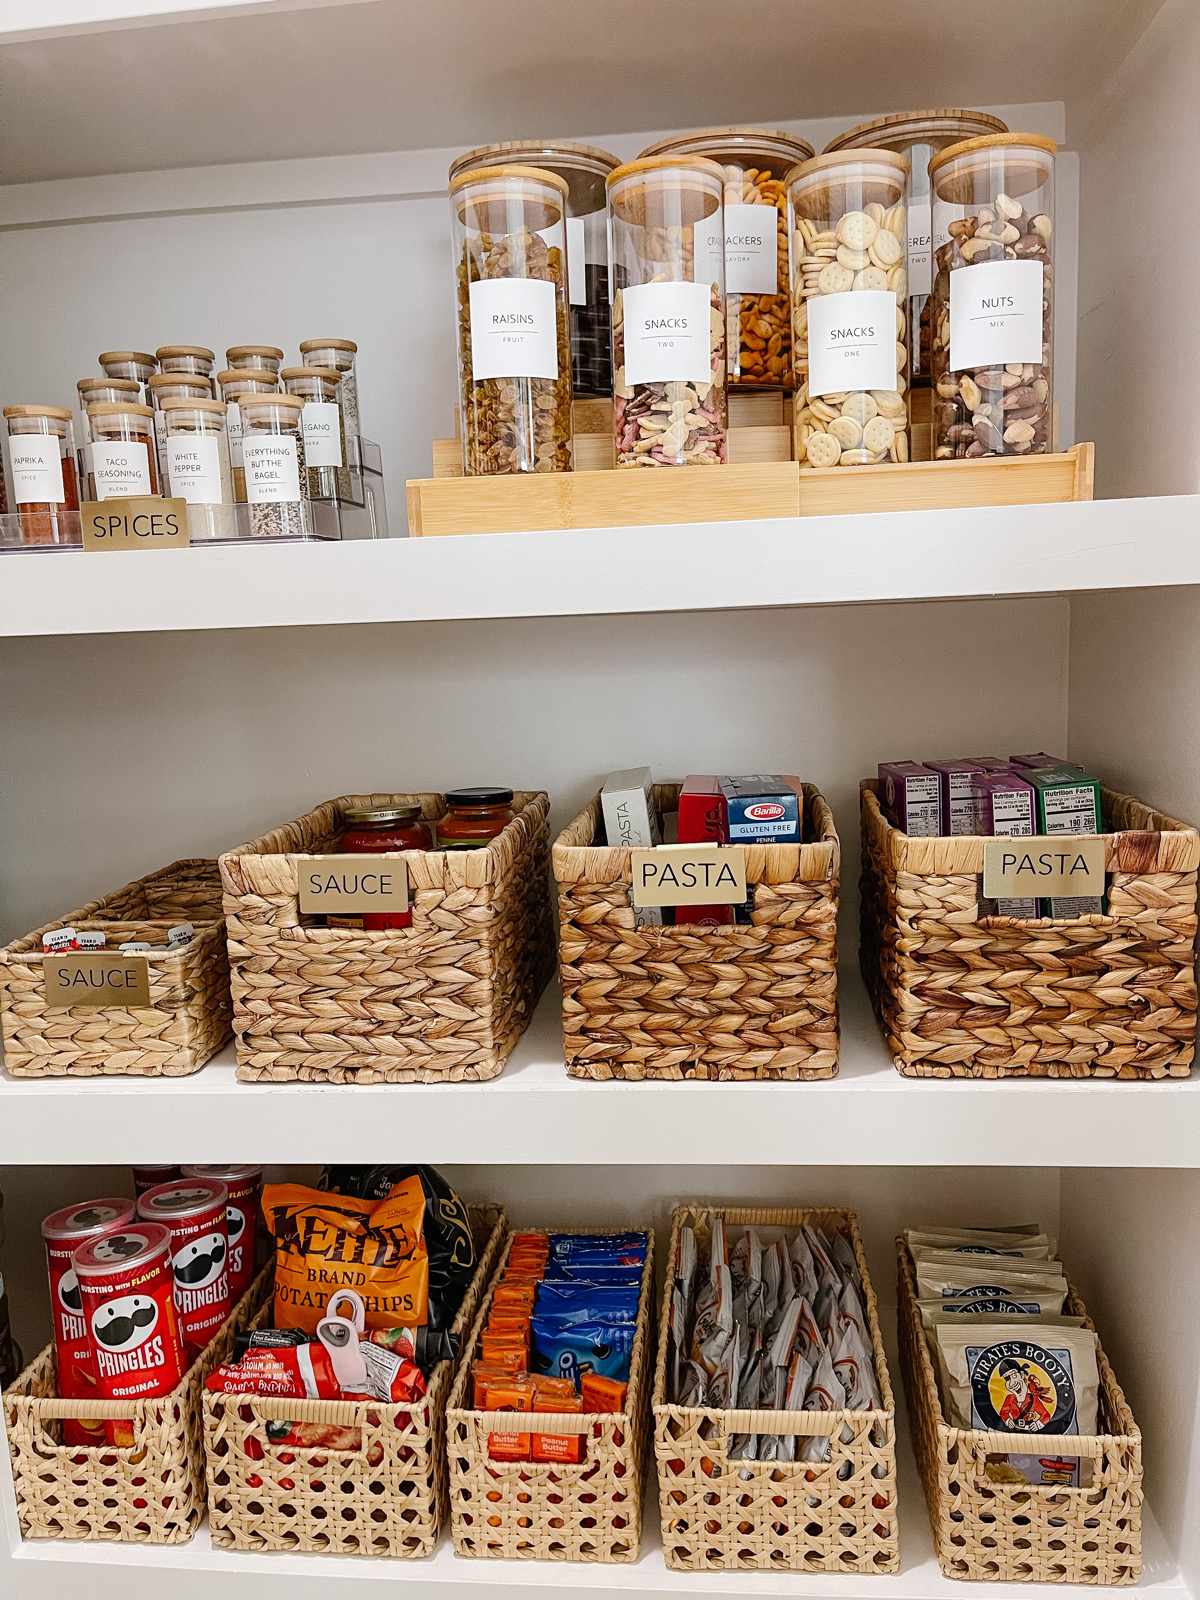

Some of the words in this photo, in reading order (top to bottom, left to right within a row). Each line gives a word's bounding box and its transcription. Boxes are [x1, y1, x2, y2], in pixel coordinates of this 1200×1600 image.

[981, 296, 1014, 309] NUTS
[492, 314, 534, 325] RAISINS
[644, 318, 688, 330] SNACKS
[989, 320, 1005, 328] MIX
[830, 326, 875, 340] SNACKS
[844, 350, 860, 358] ONE
[304, 423, 330, 431] EGANO
[174, 453, 198, 461] WHITE
[245, 448, 291, 458] EVERYTHING
[14, 457, 44, 465] PAPRIKA
[105, 458, 128, 466] TACO
[251, 460, 266, 468] BUT
[267, 459, 283, 467] THE
[174, 465, 202, 473] PEPPER
[98, 470, 142, 479] SEASONING
[254, 471, 280, 480] BAGEL
[93, 513, 180, 538] SPICES
[1016, 791, 1029, 799] Facts
[1045, 789, 1074, 798] Nutrition
[753, 806, 782, 816] Barilla
[616, 801, 633, 847] PASTA
[1047, 822, 1065, 830] Calories
[1069, 819, 1081, 827] 190
[1083, 817, 1095, 826] 260
[740, 825, 770, 834] GLUTEN
[772, 824, 791, 832] FREE
[1010, 827, 1020, 836] 270
[756, 836, 777, 844] PENNE
[1002, 853, 1090, 876] PASTA
[641, 862, 738, 888] PASTA
[309, 874, 393, 895] SAUCE
[57, 968, 138, 988] SAUCE
[170, 1225, 199, 1237] RSTING
[200, 1221, 212, 1230] WITH
[81, 1284, 114, 1294] BURSTING
[115, 1282, 131, 1291] WITH
[131, 1267, 160, 1287] FLAVOR
[307, 1268, 366, 1286] BRAND
[360, 1294, 414, 1312] HIPS
[186, 1311, 226, 1332] ORIGINAL
[96, 1335, 165, 1378] PRINGLES
[973, 1343, 1021, 1382] PIRATE'S
[1025, 1345, 1070, 1387] BOOTY
[112, 1378, 160, 1396] ORIGINAL
[493, 1435, 518, 1443] Butter
[541, 1436, 569, 1446] Peanut
[542, 1443, 568, 1452] Butter
